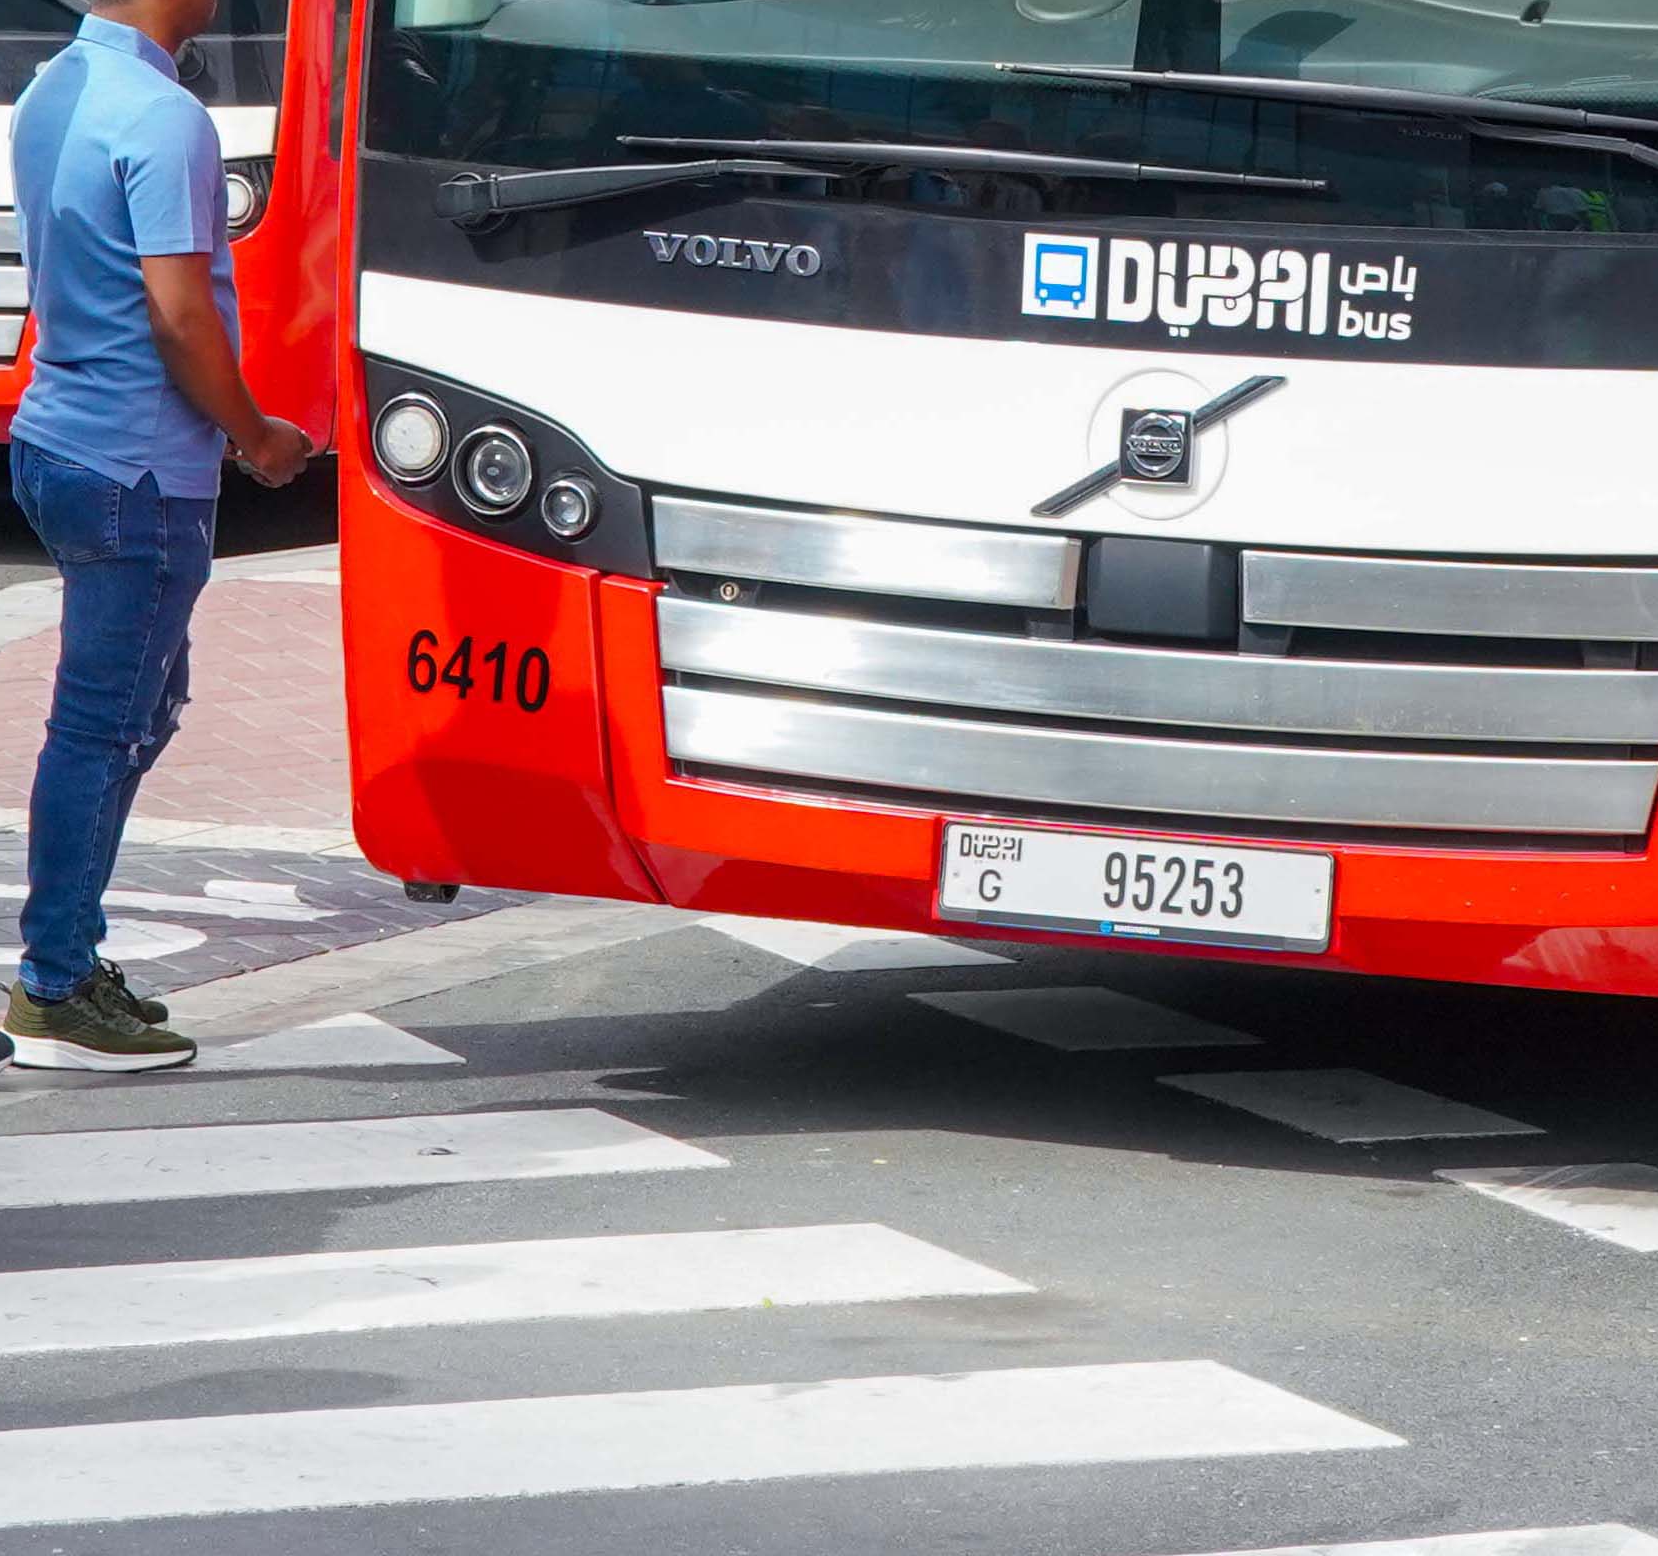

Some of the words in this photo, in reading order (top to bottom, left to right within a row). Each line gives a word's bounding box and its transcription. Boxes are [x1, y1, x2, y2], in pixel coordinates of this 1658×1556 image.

[643, 230, 821, 277] VOLVO
[1107, 238, 1330, 338] DUBAI
[1339, 255, 1417, 302] باص
[1337, 301, 1412, 341] bus
[407, 628, 550, 714] 6410
[959, 832, 1023, 864] DUBAI
[978, 869, 1002, 902] G
[1102, 851, 1244, 919] 95253
